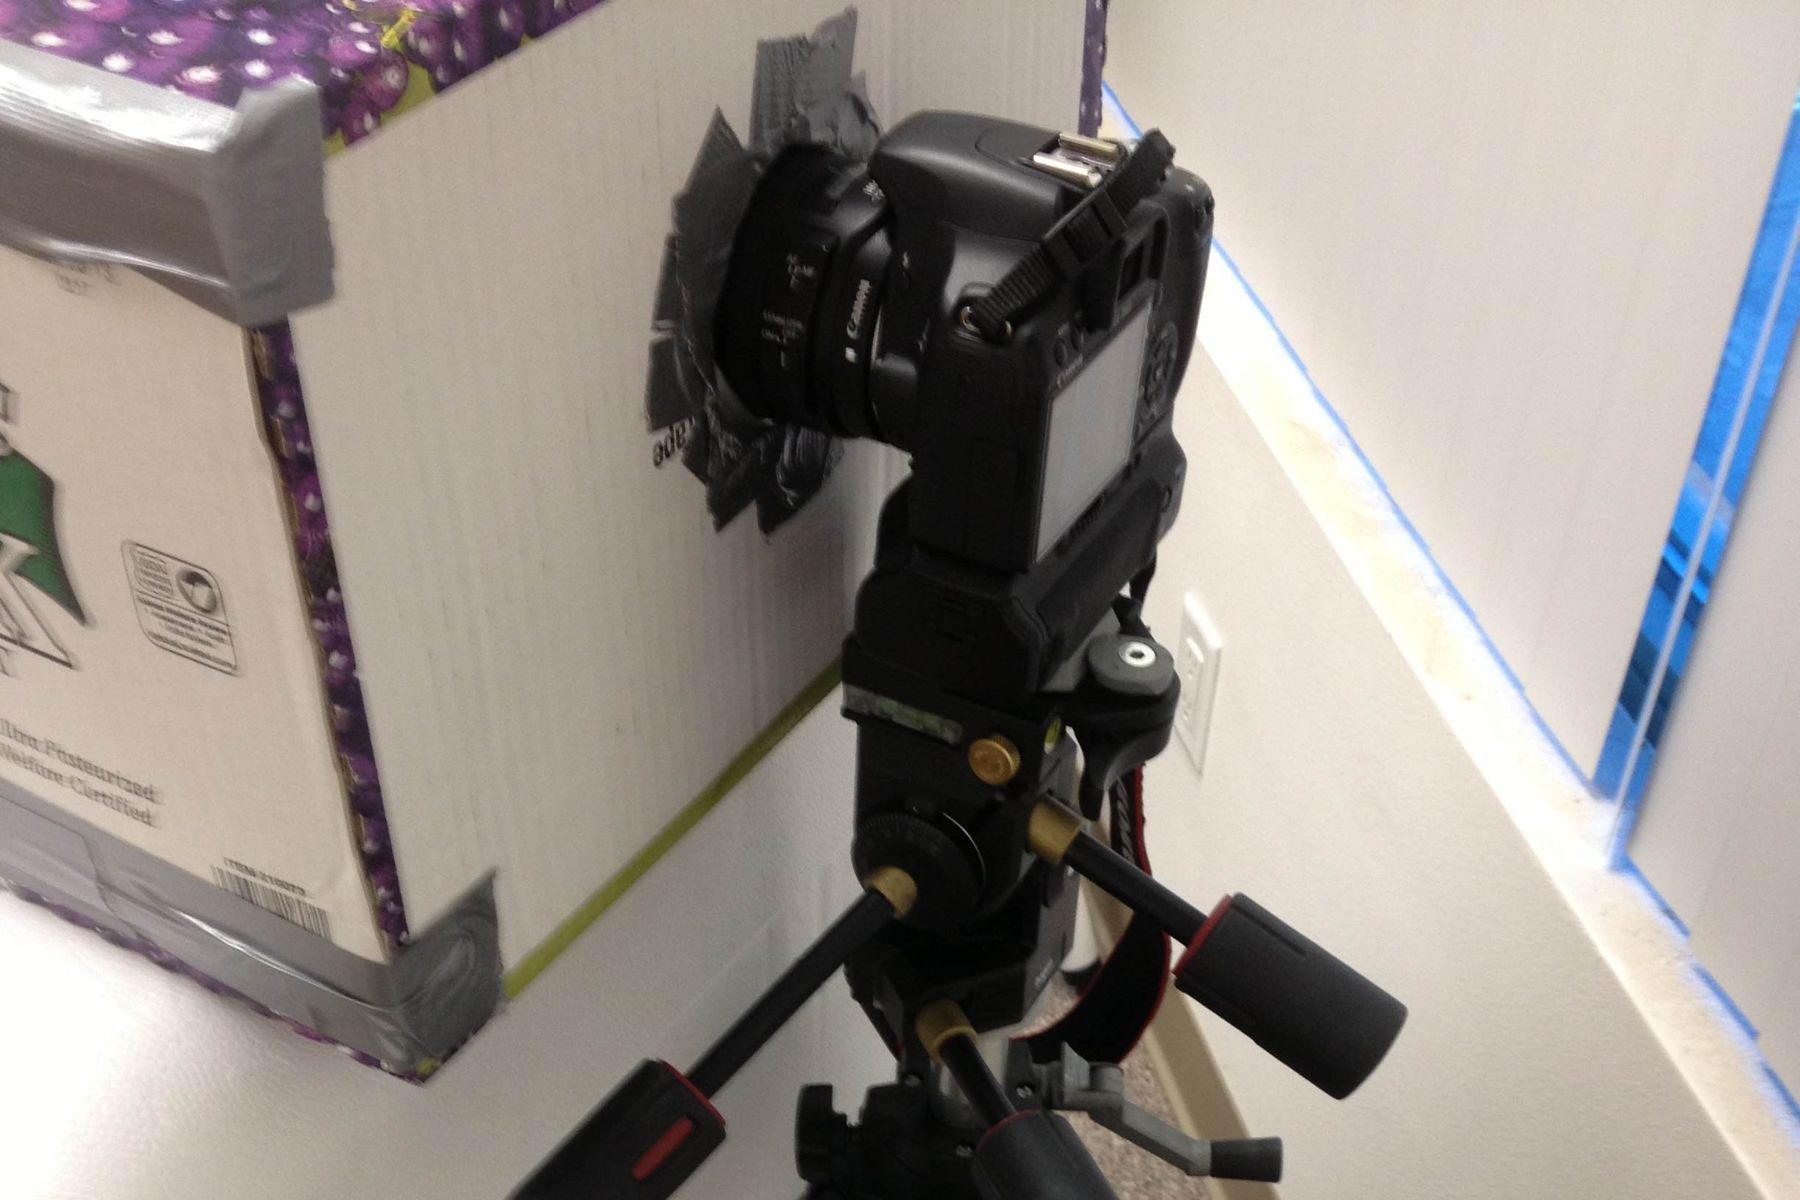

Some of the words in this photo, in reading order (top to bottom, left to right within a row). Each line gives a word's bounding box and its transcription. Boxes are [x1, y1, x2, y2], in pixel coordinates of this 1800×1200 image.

[847, 278, 871, 341] Canon
[653, 416, 696, 468] ape
[46, 738, 158, 804] Pasteurized
[69, 774, 156, 828] Certified
